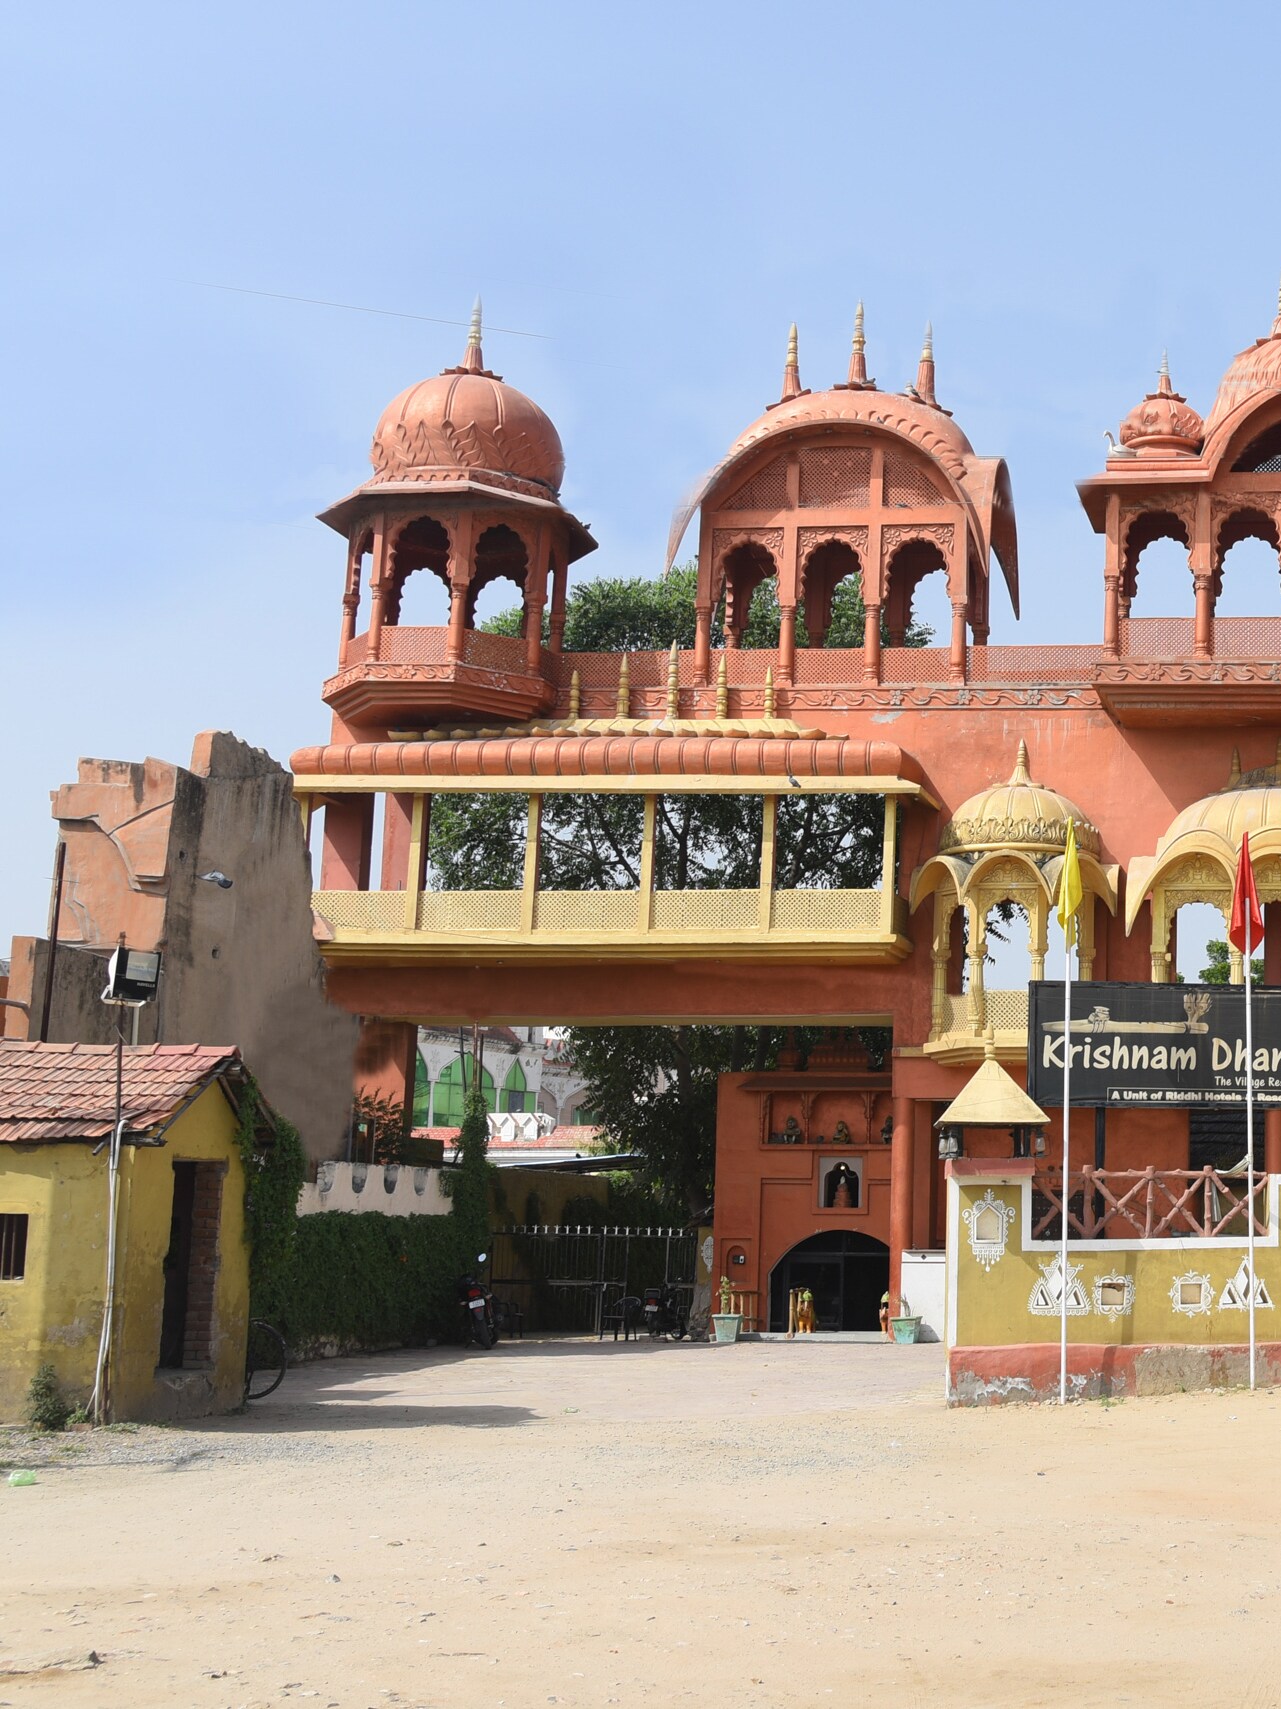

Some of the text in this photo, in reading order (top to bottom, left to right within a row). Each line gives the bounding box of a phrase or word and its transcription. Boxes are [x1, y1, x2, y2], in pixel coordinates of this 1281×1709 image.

[1042, 1034, 1197, 1071] Krishnam
[1214, 1076, 1232, 1086] The
[1110, 1090, 1121, 1100] A
[1123, 1091, 1148, 1100] Unit
[1150, 1091, 1163, 1100] of
[1204, 1092, 1242, 1101] Hotels
